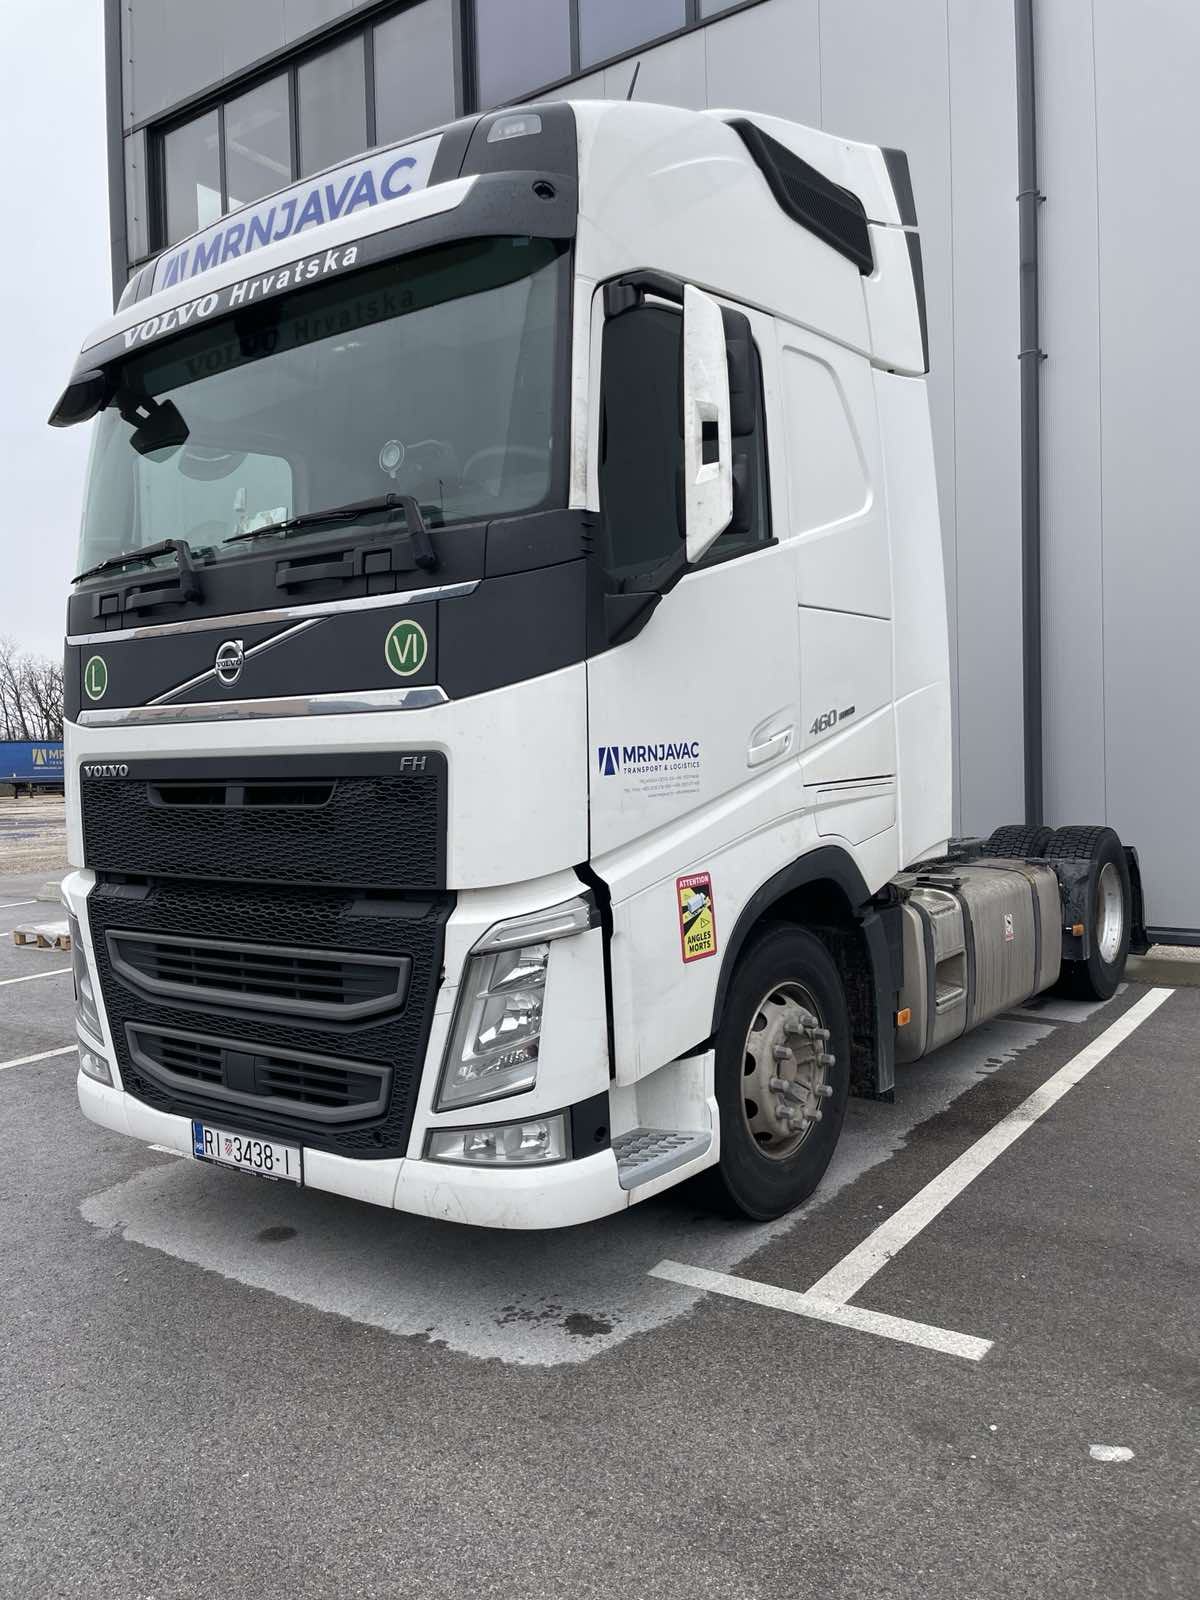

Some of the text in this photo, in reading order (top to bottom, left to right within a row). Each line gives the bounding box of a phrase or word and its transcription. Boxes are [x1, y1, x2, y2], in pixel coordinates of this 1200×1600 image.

[191, 156, 417, 277] MRNJAVAC
[123, 245, 358, 349] VOLVO Hrvatska
[392, 632, 418, 665] VI
[216, 659, 242, 668] VOLVO
[91, 663, 102, 692] L
[809, 709, 837, 735] 460
[623, 741, 700, 764] MRNJAVAC
[84, 756, 427, 777] VOLVO FH
[624, 764, 662, 775] TRANSPORT
[670, 761, 700, 770] LOGISTICS
[679, 875, 709, 888] ATTENTION
[687, 931, 711, 945] ANGLES
[689, 940, 711, 953] MORTS
[204, 1129, 289, 1175] RI 3438-I
